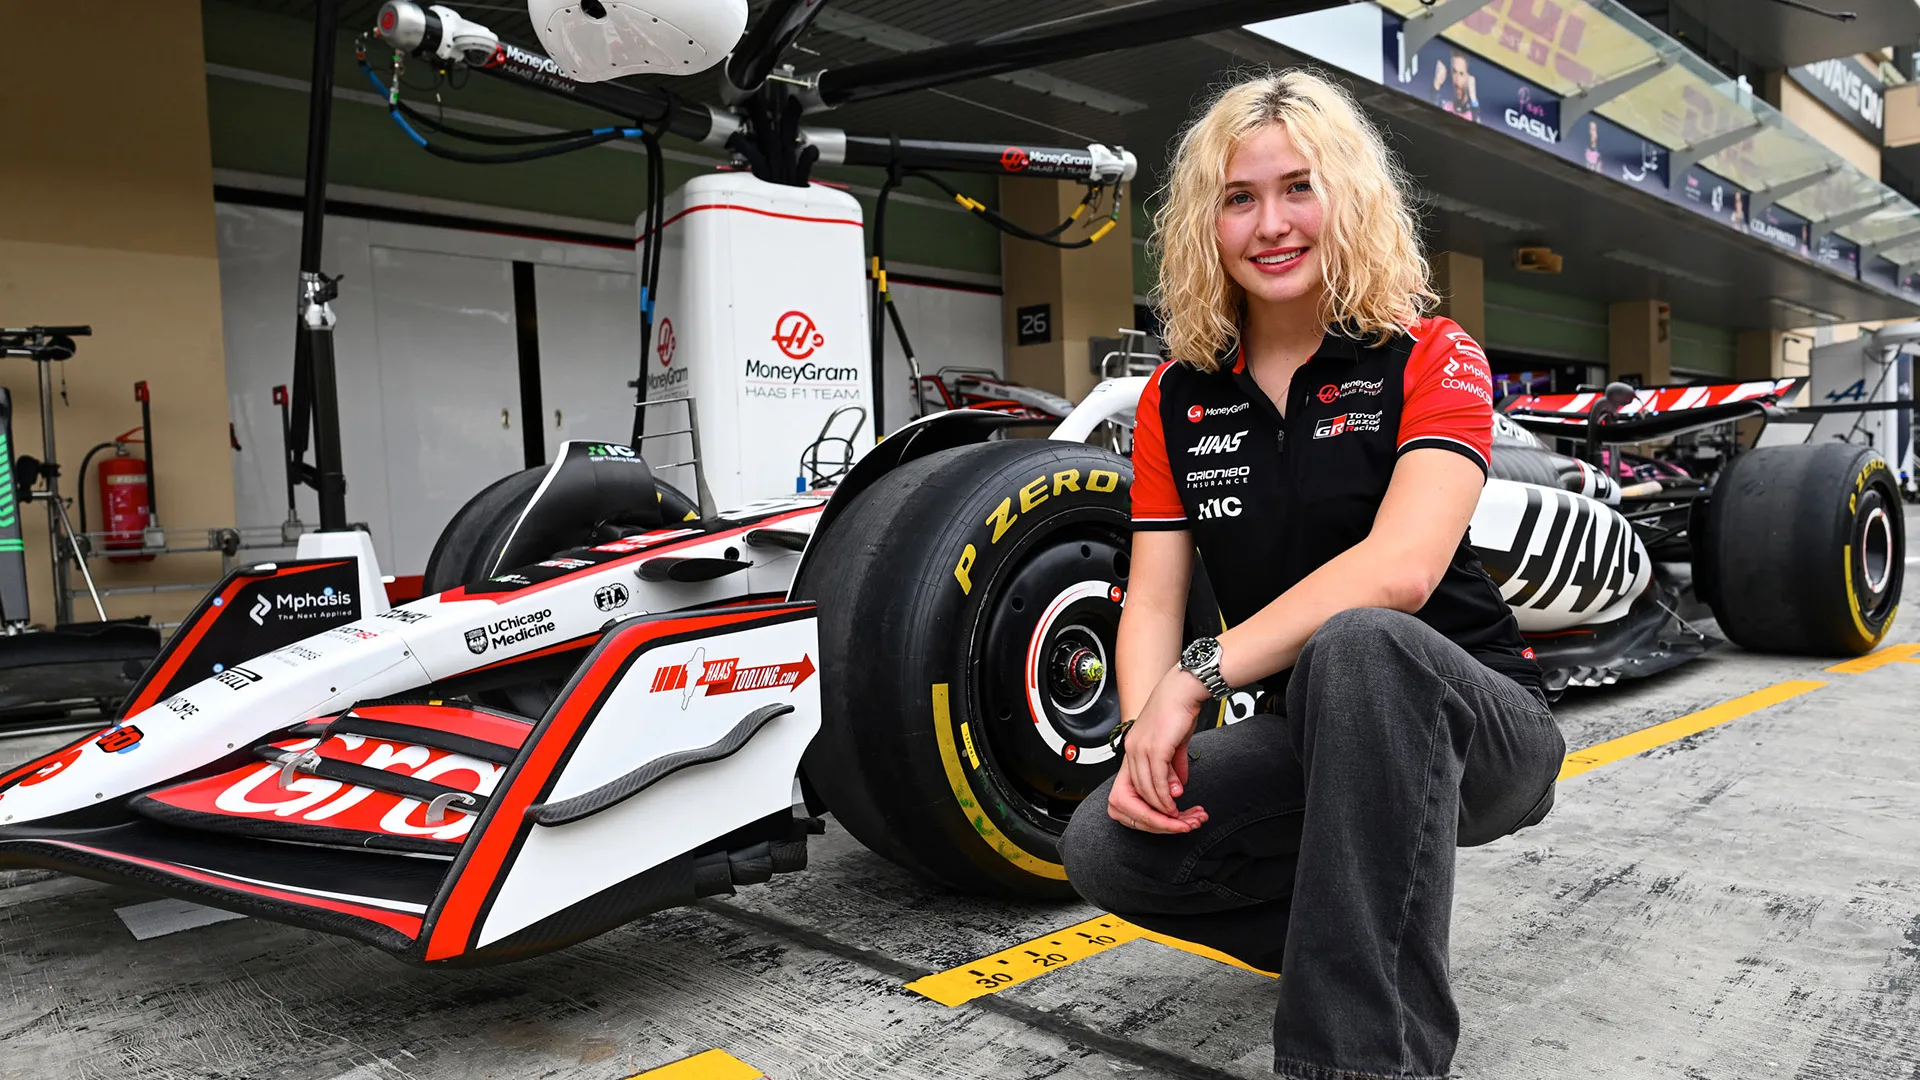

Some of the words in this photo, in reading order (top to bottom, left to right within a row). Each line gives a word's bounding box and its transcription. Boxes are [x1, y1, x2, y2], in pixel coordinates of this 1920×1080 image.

[506, 45, 570, 78] MoneyGra
[1861, 83, 1884, 129] ON
[1505, 108, 1558, 144] GASLY
[1029, 151, 1093, 166] MoneyGram
[1021, 313, 1047, 335] 26
[745, 359, 858, 384] MoneyGram
[745, 386, 787, 399] HAAS
[791, 388, 807, 399] F1
[812, 389, 860, 400] TEAM
[1441, 377, 1493, 405] COMMSCO
[1204, 402, 1250, 416] MoneyGram
[1187, 430, 1249, 456] HAAS
[1315, 423, 1346, 437] GR
[1186, 477, 1249, 489] INSURANCE
[1856, 458, 1885, 493] ZERO
[985, 468, 1119, 545] ZERO
[276, 591, 351, 612] Mphasis
[320, 610, 352, 618] Applied
[487, 608, 552, 635] UChicago
[491, 621, 556, 649] Medicine
[704, 660, 735, 682] HAAS
[214, 730, 505, 840] Gra
[975, 972, 1014, 989] 30
[1032, 953, 1068, 967] 20
[1088, 935, 1117, 947] 10
